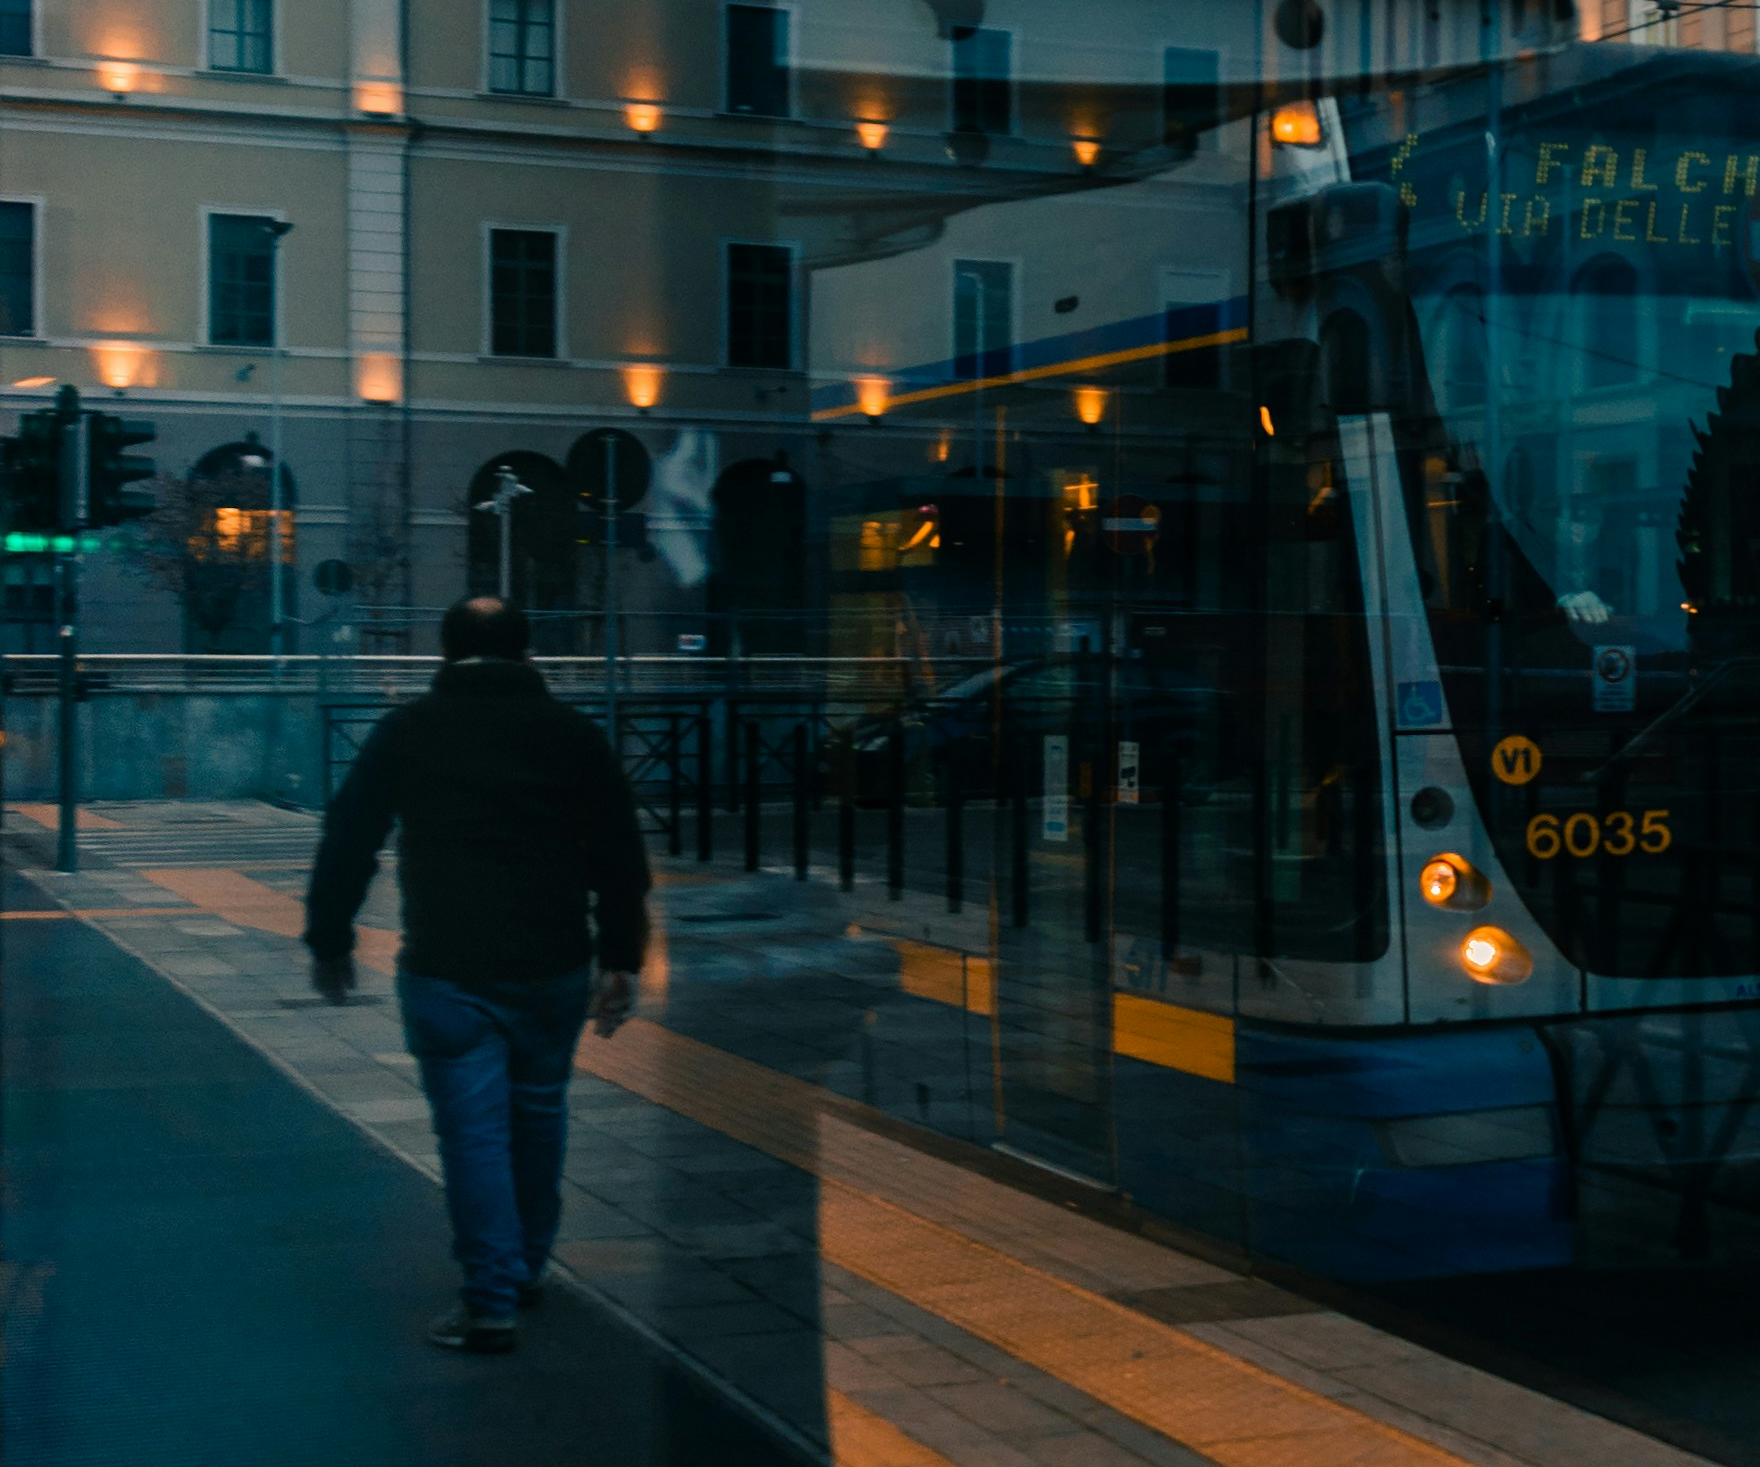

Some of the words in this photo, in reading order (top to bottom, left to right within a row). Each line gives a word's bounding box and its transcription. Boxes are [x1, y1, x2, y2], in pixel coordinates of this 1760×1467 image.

[1455, 190, 1551, 238] VIA
[1579, 196, 1737, 246] DELLE
[1500, 747, 1532, 775] V1
[1525, 808, 1673, 860] 6035
